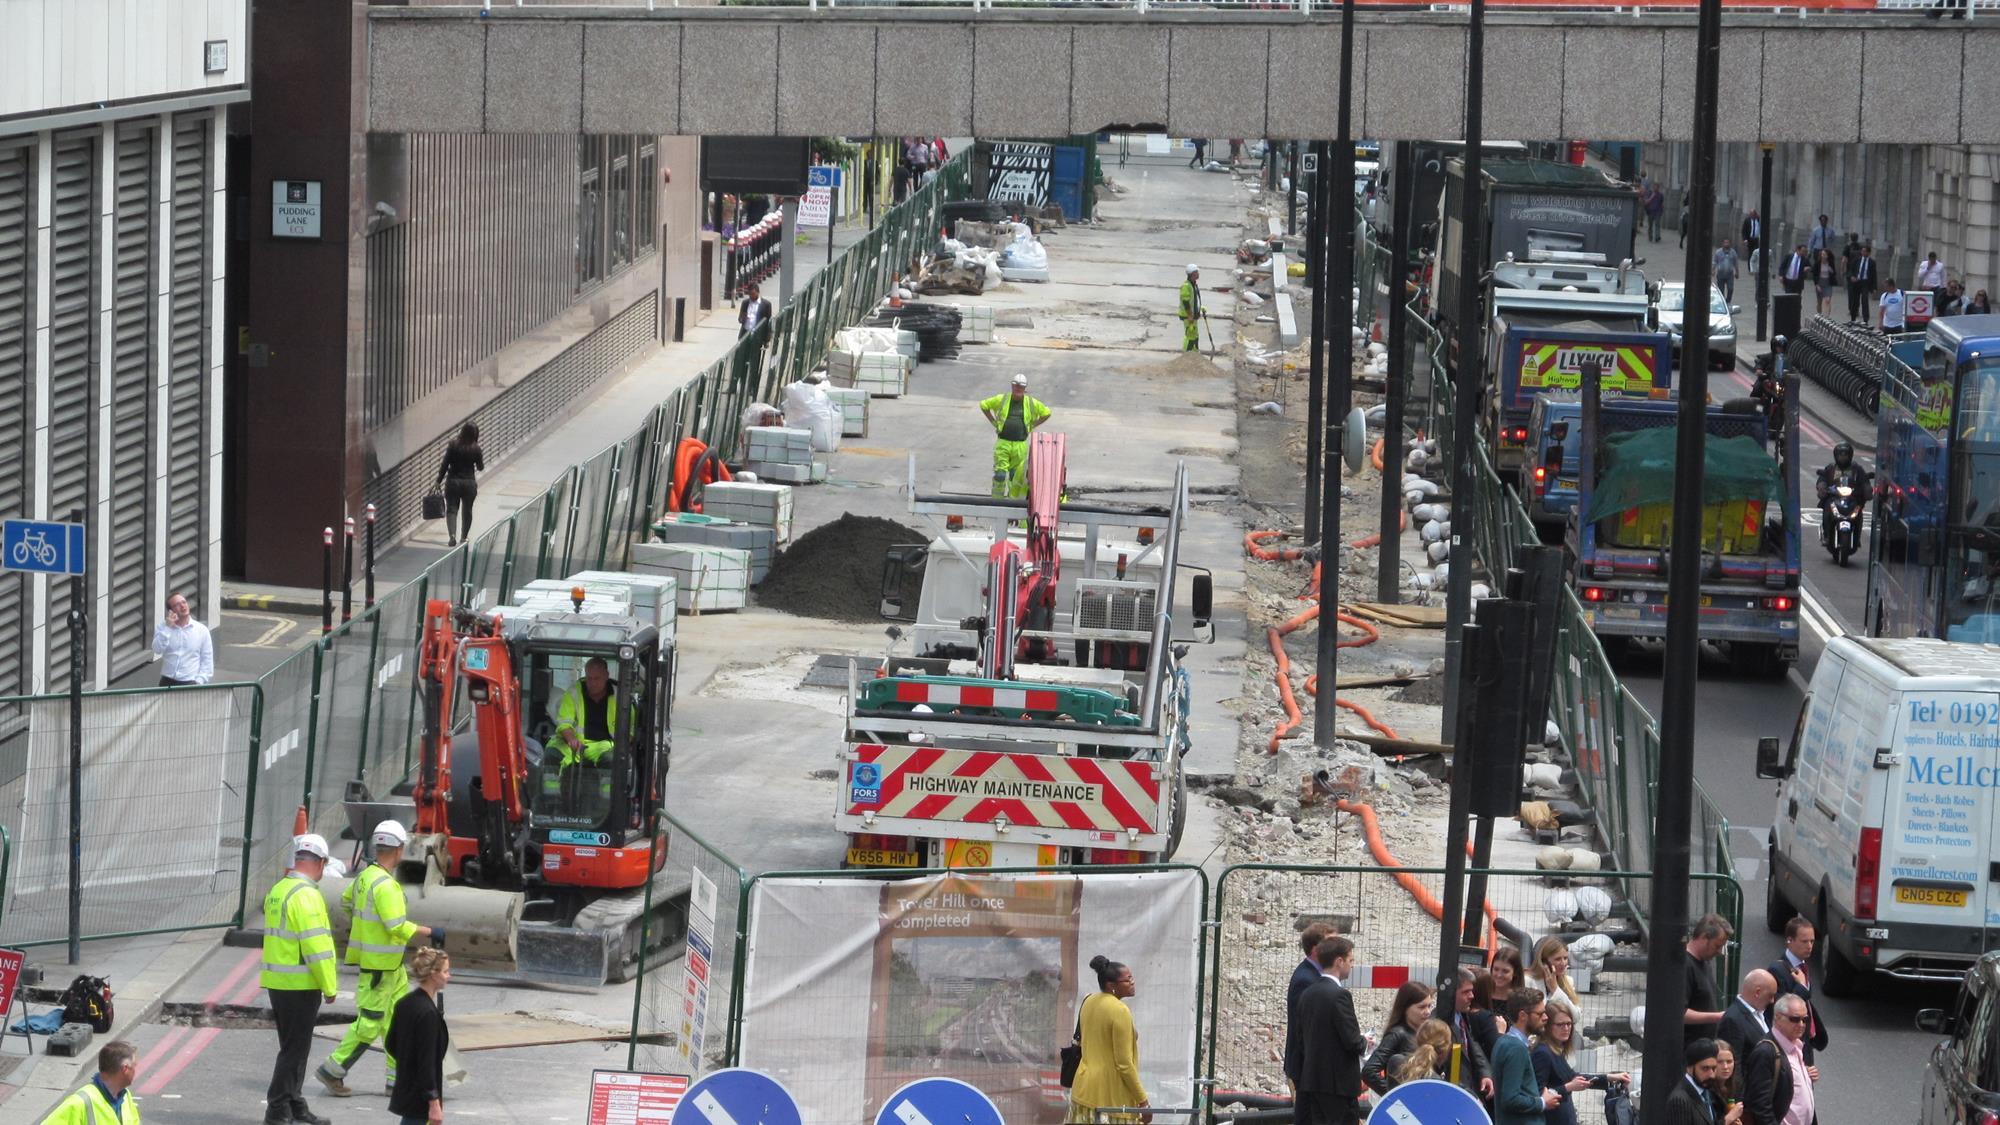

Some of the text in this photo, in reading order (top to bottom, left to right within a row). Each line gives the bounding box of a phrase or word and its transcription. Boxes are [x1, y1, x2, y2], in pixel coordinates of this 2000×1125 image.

[278, 207, 316, 217] PUDDING
[286, 216, 308, 225] LANE
[1547, 375, 1579, 386] Highway
[1949, 701, 1999, 727] 0192
[853, 788, 877, 798] FORS
[909, 776, 1096, 801] HIGHWAY MAINTENANCE
[1905, 793, 1976, 807] Towels Bath Robes
[1911, 807, 1968, 819] Sheets Pillows
[1907, 820, 1969, 834] Duvets Blankets
[1903, 834, 1972, 848] Mattress Protectors
[851, 850, 916, 865] Y656 HWT
[1891, 865, 1978, 881] www.mellcrest.com
[942, 893, 966, 909] Hill
[970, 897, 1006, 910] once
[1901, 887, 1961, 904] GN05 CZC
[894, 913, 971, 932] completed
